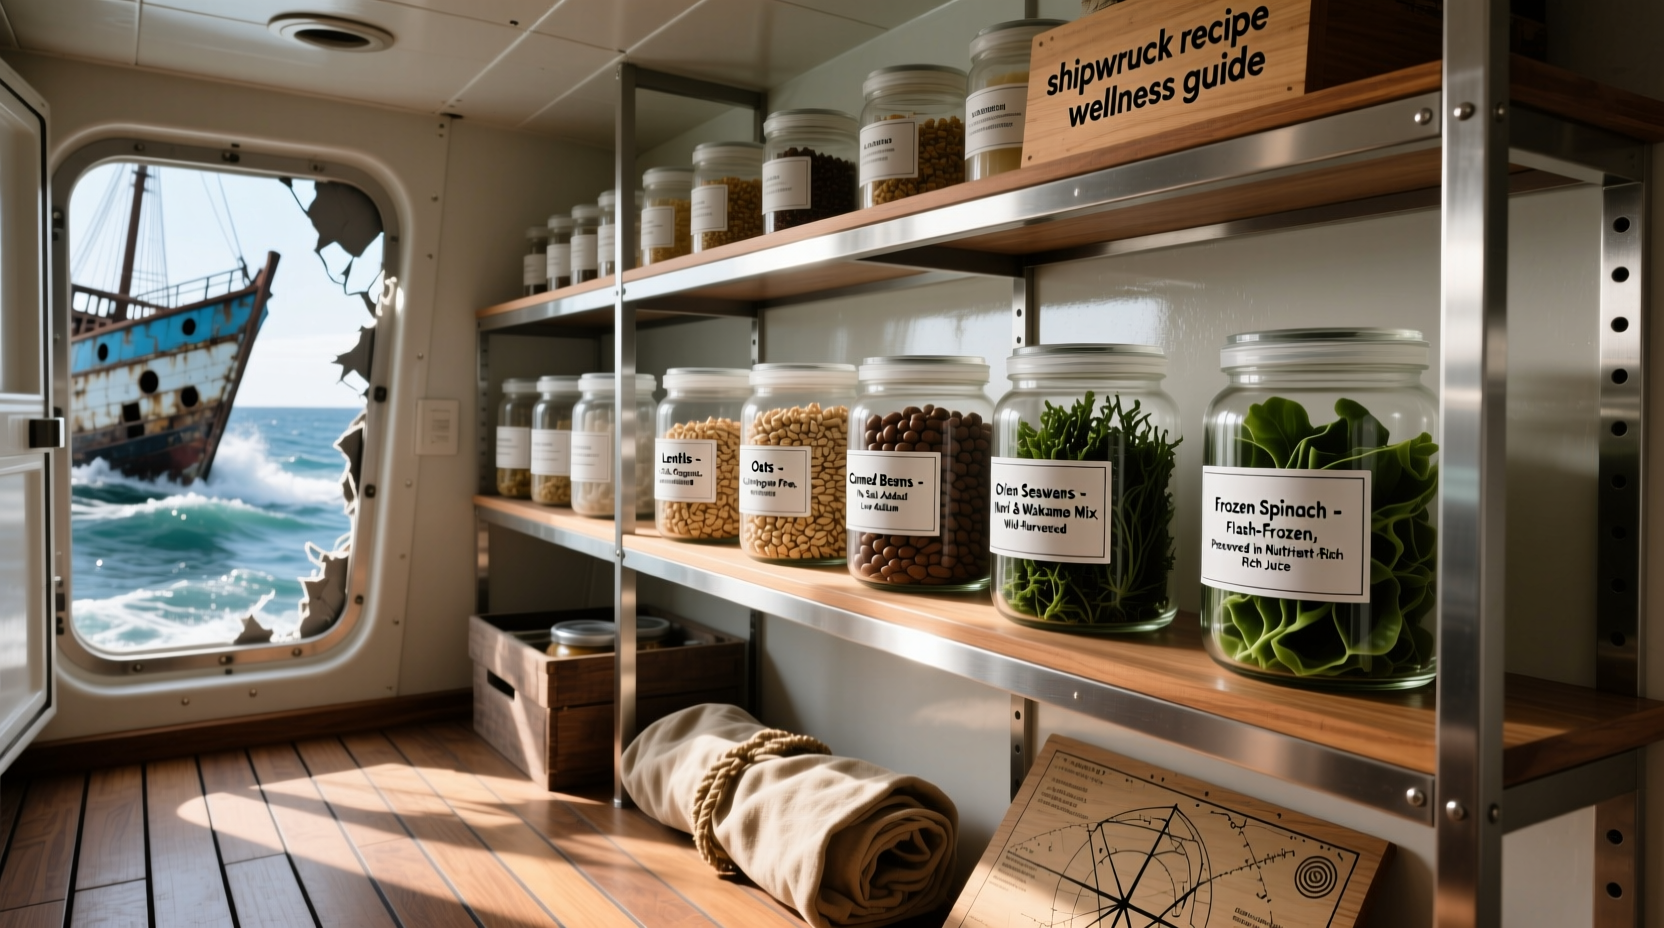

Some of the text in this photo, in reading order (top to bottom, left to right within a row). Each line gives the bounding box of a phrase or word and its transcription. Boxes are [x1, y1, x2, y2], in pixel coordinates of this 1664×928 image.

[1046, 5, 1269, 96] shipwruck recipe
[1068, 77, 1175, 128] wellness
[1182, 45, 1266, 104] guide
[1075, 505, 1098, 520] Mix
[1215, 496, 1255, 515] Frozen
[1259, 499, 1327, 521] Spinach
[1226, 521, 1318, 544] Flash-Frozen,
